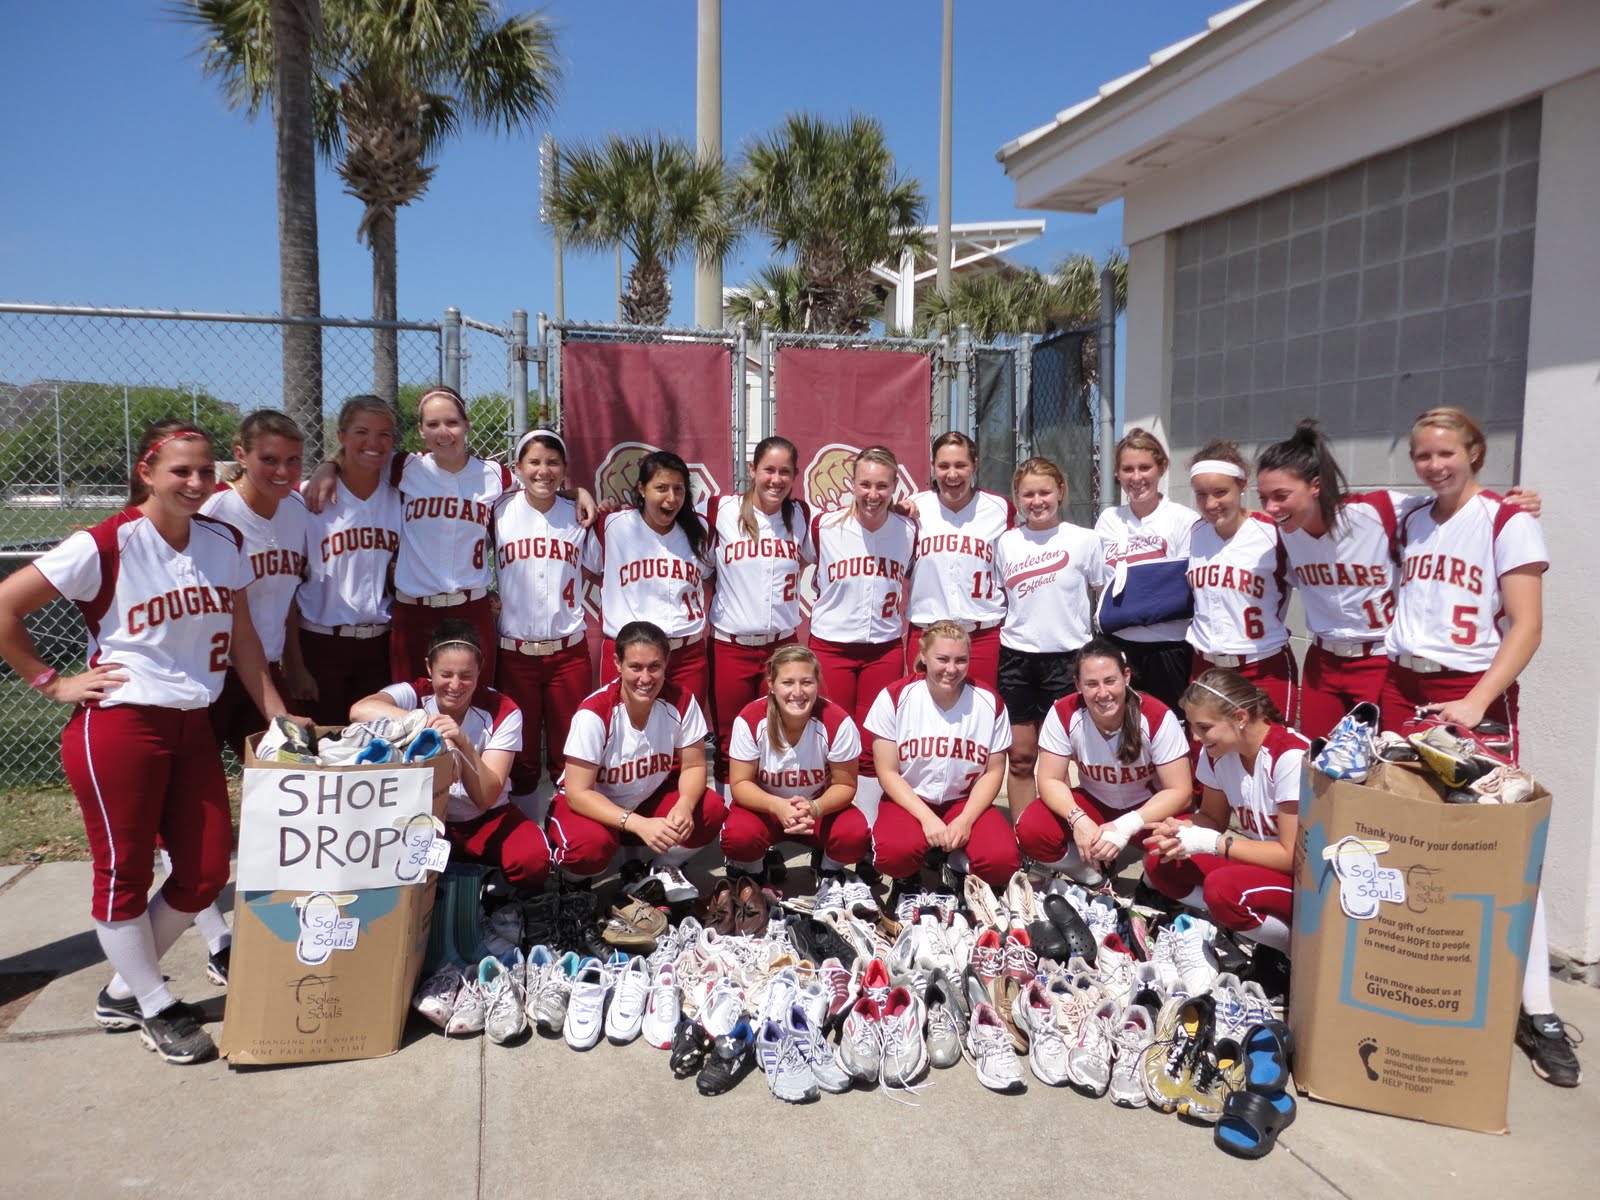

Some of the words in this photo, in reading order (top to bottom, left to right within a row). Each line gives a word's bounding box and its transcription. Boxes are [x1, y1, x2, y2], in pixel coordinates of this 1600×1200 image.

[321, 527, 399, 562] COUGAR
[472, 539, 485, 570] 8
[499, 537, 580, 570] COUGARS
[914, 534, 993, 564] COUGARS
[250, 549, 307, 580] UGAR
[619, 558, 701, 588] COUGARS
[828, 555, 905, 583] COUGARS
[1295, 563, 1387, 588] OUGARS
[1400, 554, 1483, 596] OUGARS
[562, 578, 575, 608] 4
[1018, 572, 1056, 599] Softball
[1187, 565, 1265, 599] OUGARS
[1362, 589, 1395, 630] 12
[1244, 606, 1265, 640] 6
[1451, 605, 1479, 647] 5
[897, 736, 988, 765] COUGARS
[596, 753, 672, 784] COUGAR
[759, 764, 831, 788] OUGAR
[1079, 761, 1156, 784] OUGARS
[278, 774, 399, 817] SHOE
[959, 772, 981, 795] 7
[279, 825, 400, 869] DROP
[411, 833, 446, 851] Soles
[1355, 822, 1386, 838] Thank
[1388, 832, 1406, 844] you
[1409, 836, 1425, 848] for
[1427, 841, 1450, 852] your
[1451, 840, 1498, 851] donation!
[409, 852, 446, 869] Souls
[1350, 862, 1396, 880] Soles
[1356, 883, 1403, 901] Souls
[1367, 877, 1379, 889] 4
[1415, 880, 1445, 892] Soles
[313, 916, 354, 930] Soles
[325, 928, 336, 937] 4
[1378, 915, 1396, 927] Your
[1397, 921, 1414, 931] gift
[1415, 925, 1426, 934] of
[1427, 927, 1465, 937] footwear
[313, 933, 354, 948] Souls
[1364, 938, 1373, 946] in
[1374, 940, 1396, 953] need
[1397, 947, 1429, 961] around
[1430, 952, 1445, 962] the
[1446, 954, 1472, 963] world.
[1368, 926, 1405, 942] provides
[1407, 935, 1431, 948] HOPE
[1432, 941, 1441, 949] to
[1442, 941, 1471, 951] people
[1364, 971, 1389, 985] Learn
[1390, 980, 1413, 991] more
[1415, 985, 1439, 995] about
[306, 993, 340, 1005] Soles
[1366, 982, 1459, 1012] GiveShoes.org
[307, 1005, 343, 1019] Souls
[251, 1048, 273, 1056] ONE
[280, 1047, 304, 1055] PAIR
[341, 1044, 365, 1053] TIME
[252, 1038, 305, 1046] CHANGING
[311, 1037, 327, 1045] THE
[1384, 1058, 1413, 1071] around
[1415, 1065, 1429, 1073] the
[1430, 1068, 1454, 1076] world
[1385, 1046, 1400, 1057] 300
[1402, 1051, 1431, 1063] million
[1432, 1055, 1465, 1066] children
[1382, 1077, 1403, 1088] HELP
[1404, 1082, 1433, 1094] TODAY!
[1383, 1068, 1416, 1081] without
